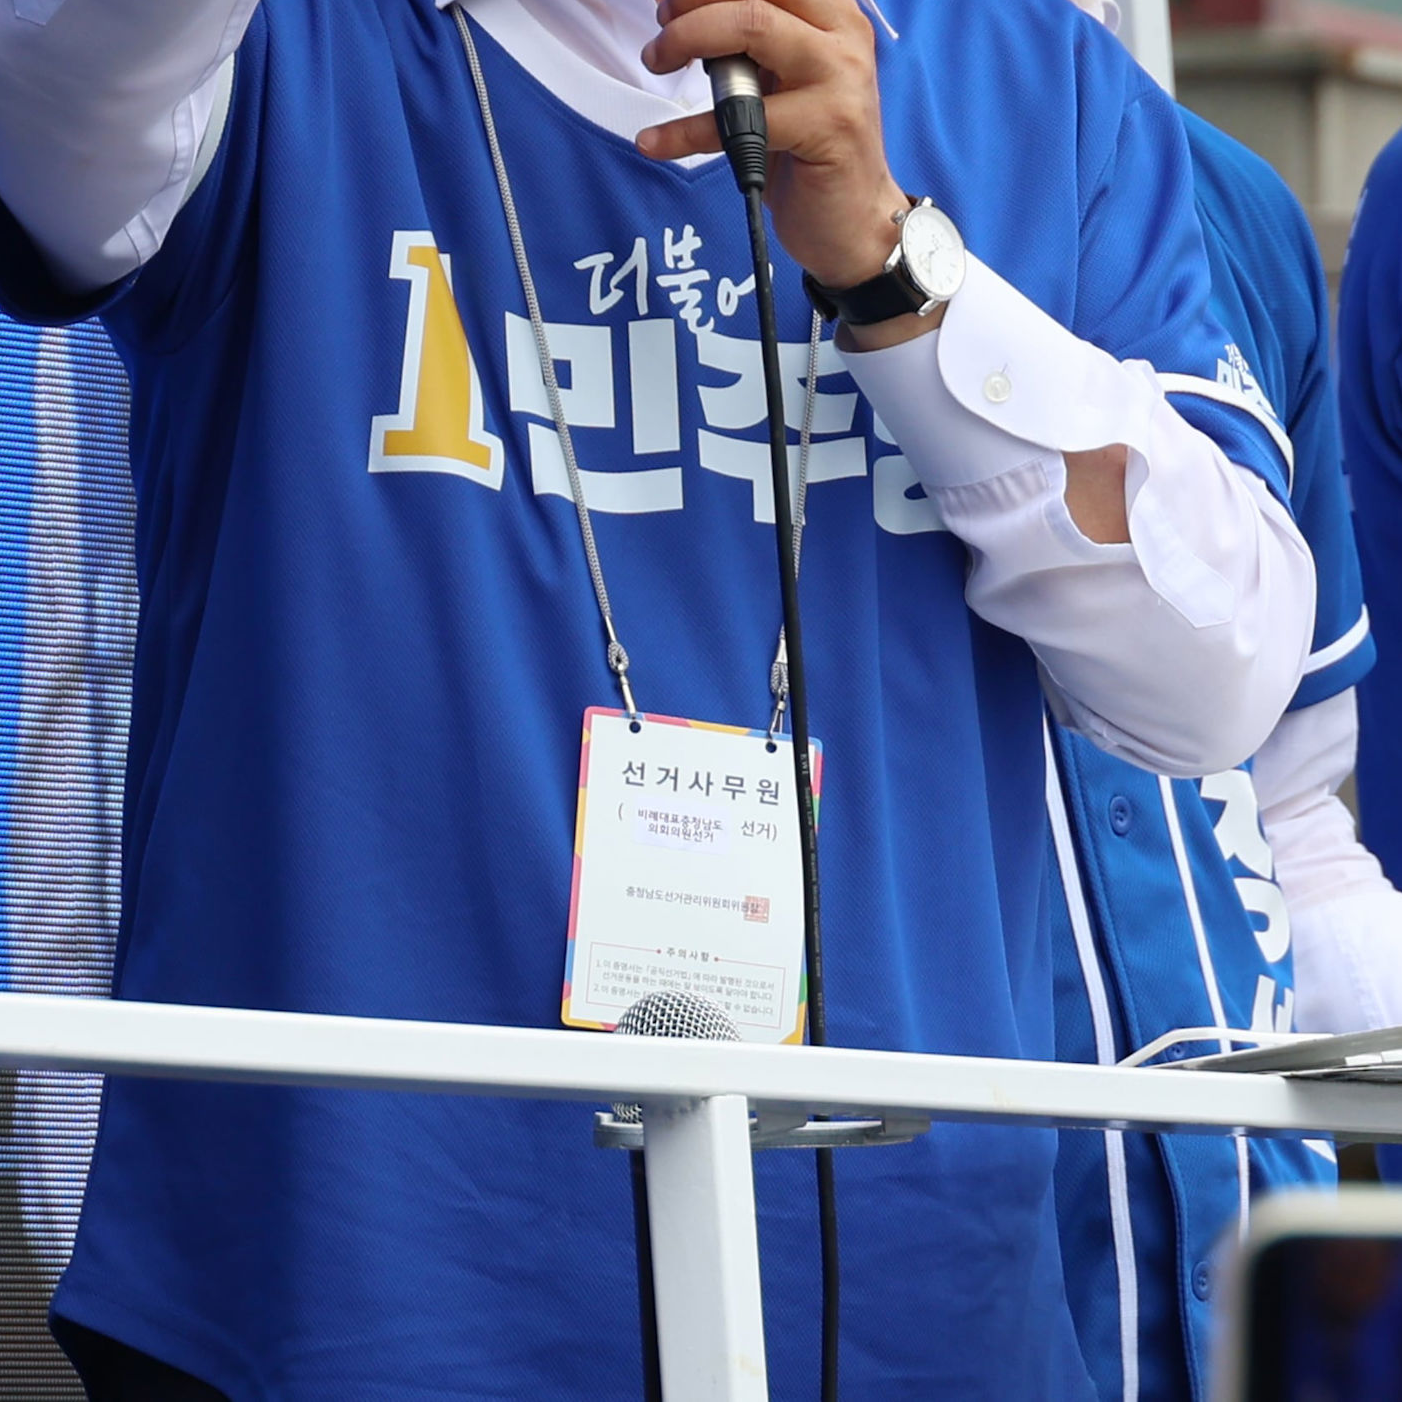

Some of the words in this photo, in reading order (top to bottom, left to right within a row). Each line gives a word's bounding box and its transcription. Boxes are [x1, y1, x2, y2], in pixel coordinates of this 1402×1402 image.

[367, 230, 504, 491] 1
[505, 311, 950, 535] 민주
[622, 760, 780, 806] 선거사무원
